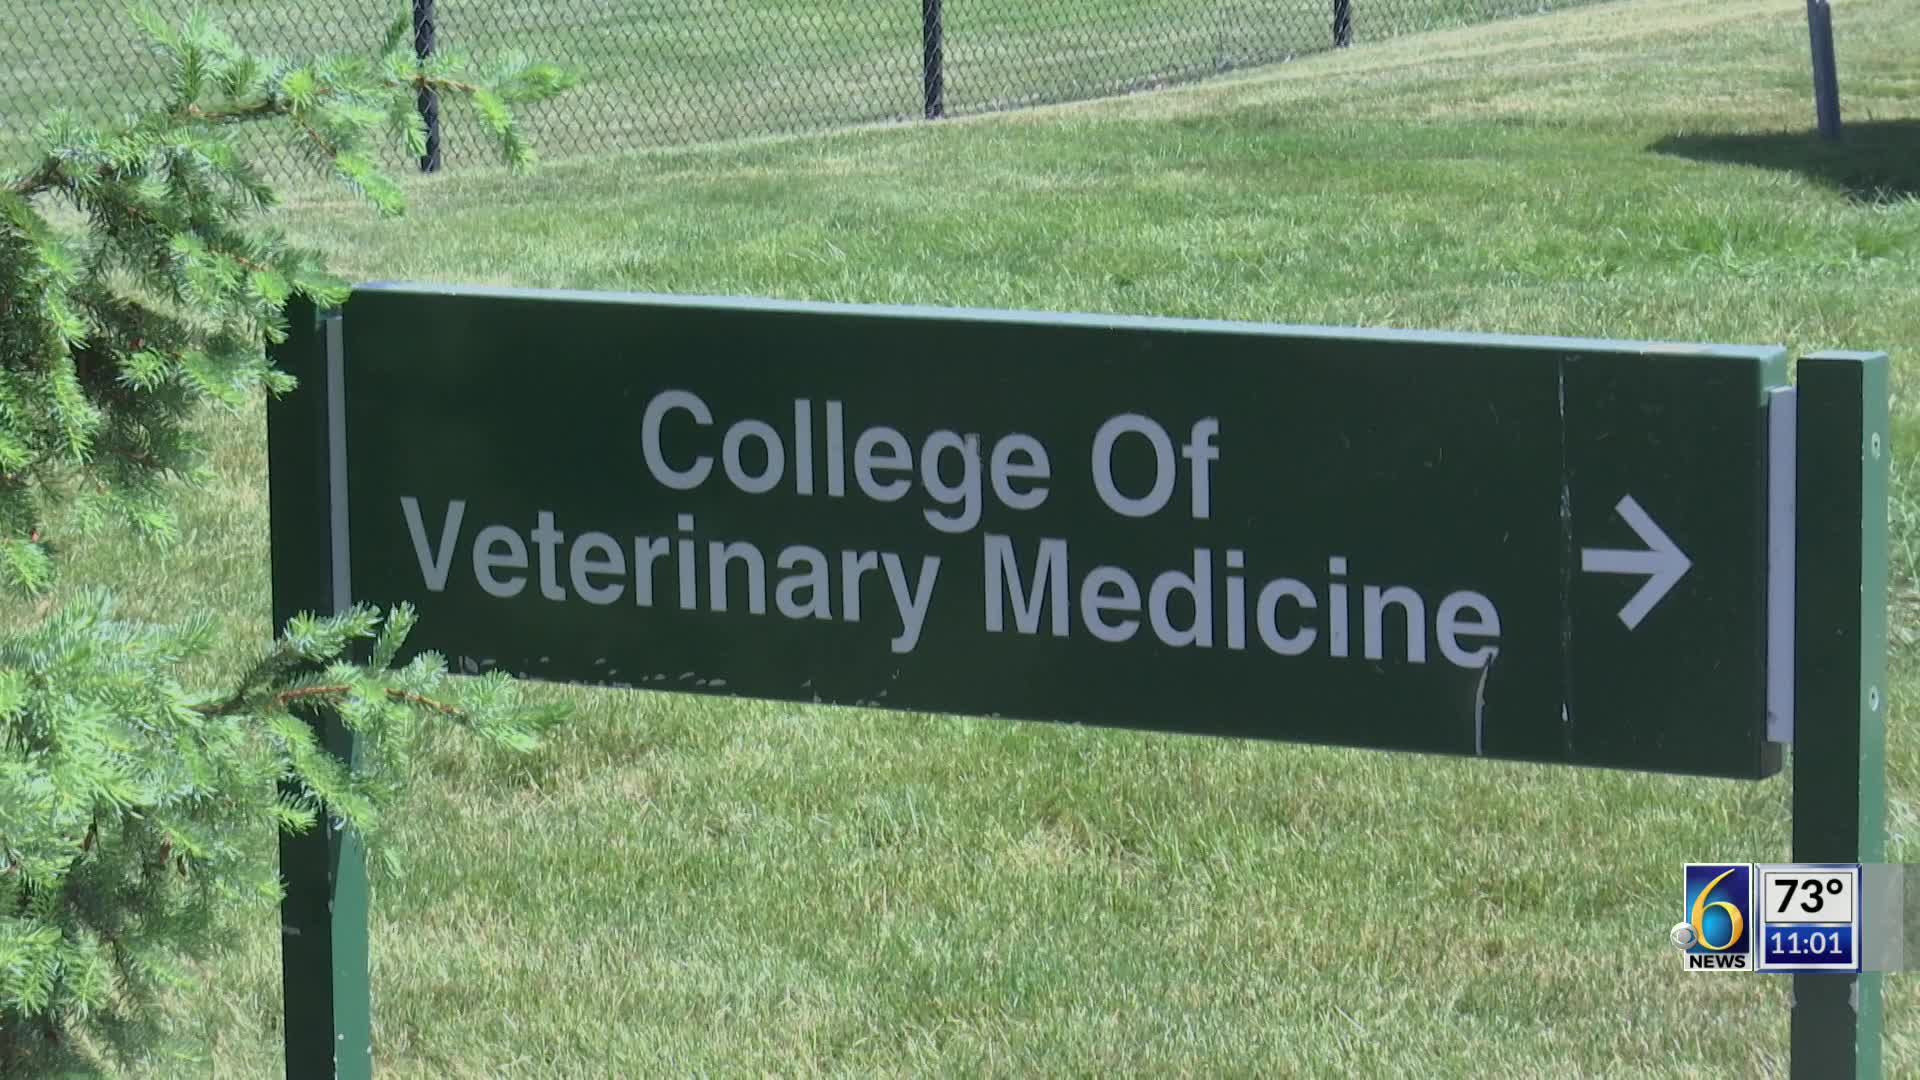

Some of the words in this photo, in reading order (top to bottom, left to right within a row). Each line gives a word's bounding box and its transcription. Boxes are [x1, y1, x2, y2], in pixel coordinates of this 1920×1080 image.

[642, 391, 1050, 533] College
[1092, 414, 1219, 518] Of
[401, 498, 941, 653] Veterinary
[984, 535, 1500, 668] Medicine
